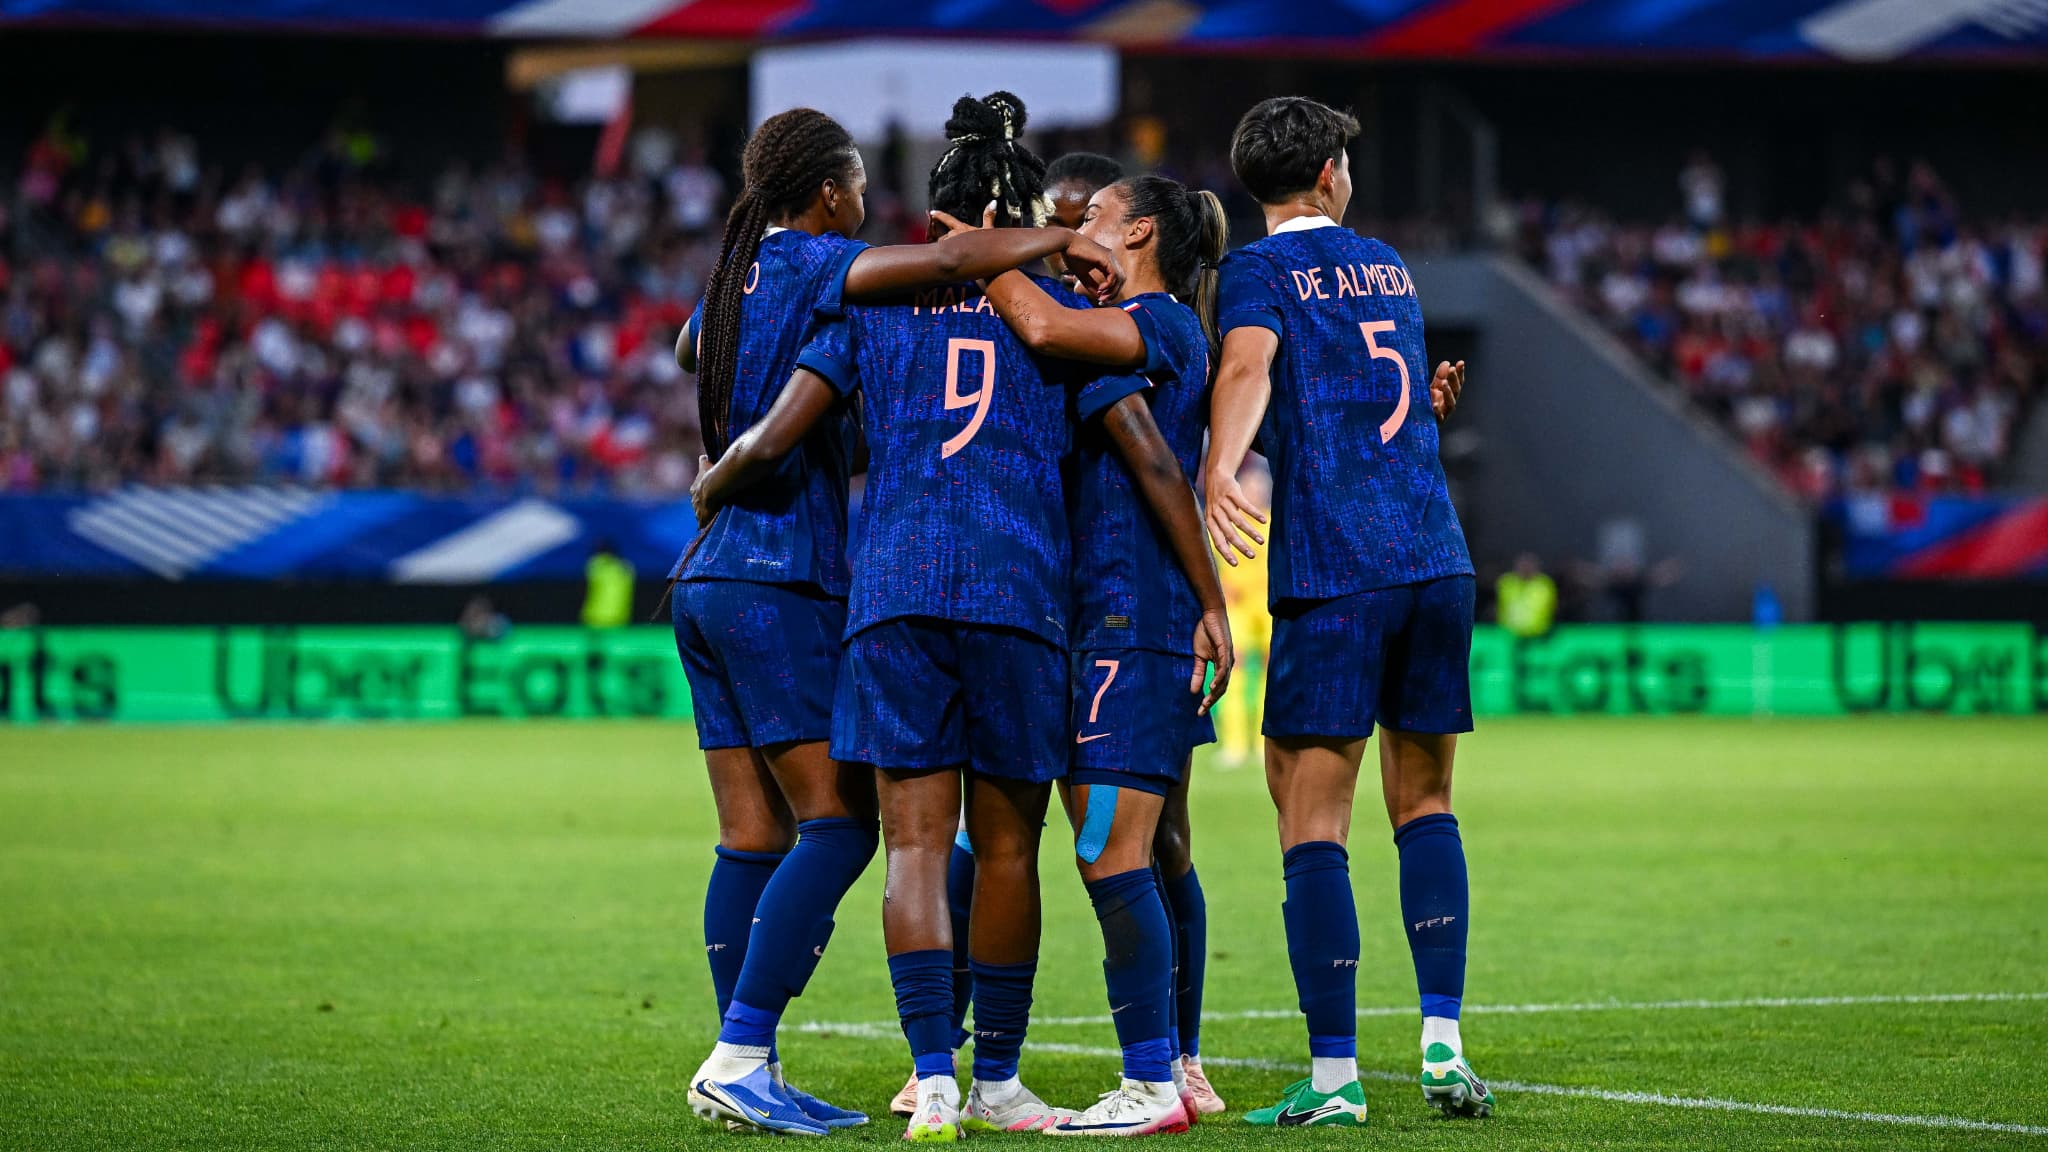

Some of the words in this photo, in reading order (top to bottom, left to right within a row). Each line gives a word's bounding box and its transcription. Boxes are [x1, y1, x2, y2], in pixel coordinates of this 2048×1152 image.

[913, 286, 1001, 318] MALA
[1291, 267, 1330, 301] DE
[941, 338, 996, 460] 9
[1359, 319, 1410, 445] 5
[0, 628, 119, 718] ts
[1088, 659, 1120, 723] 7
[1414, 916, 1456, 932] FFF
